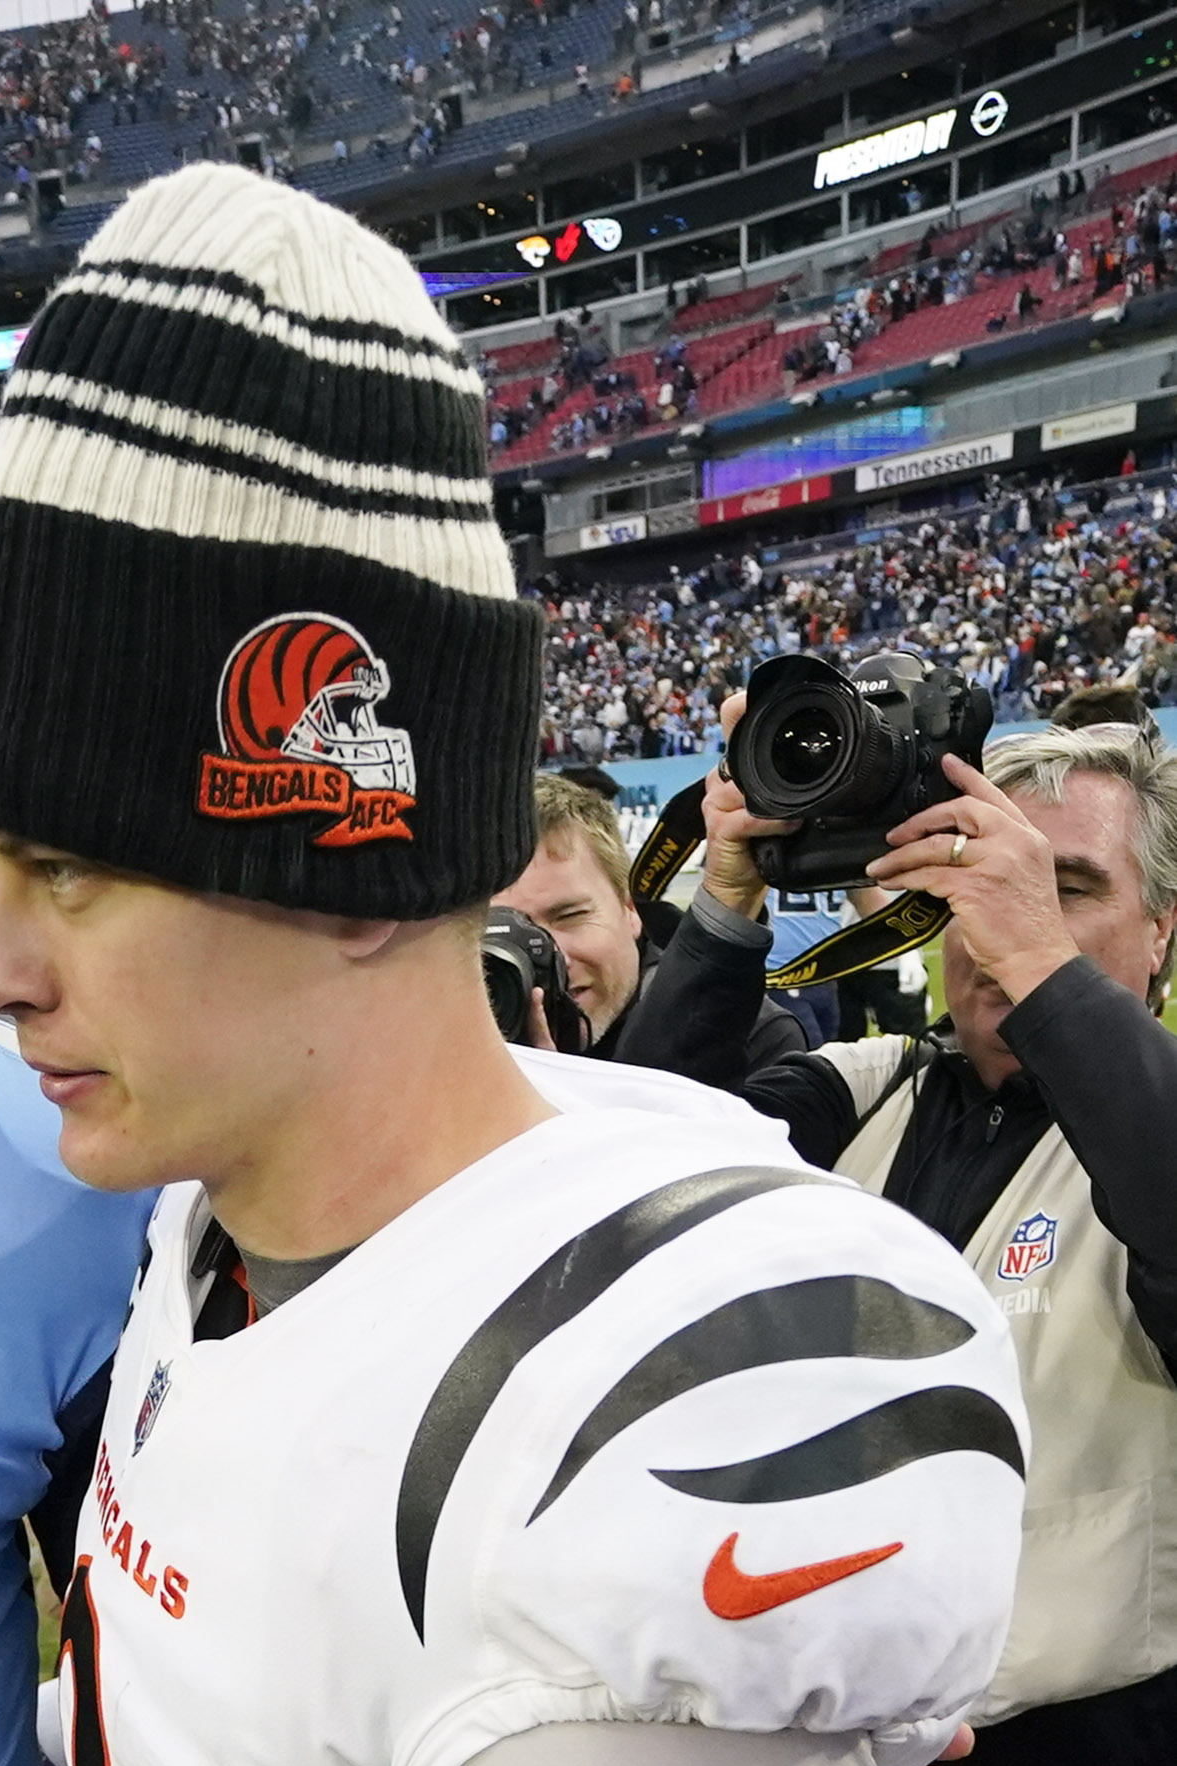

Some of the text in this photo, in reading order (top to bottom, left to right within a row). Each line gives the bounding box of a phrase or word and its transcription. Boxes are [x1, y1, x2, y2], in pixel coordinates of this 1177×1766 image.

[208, 767, 342, 809] BENGALS
[349, 798, 397, 833] AFC
[1004, 1244, 1047, 1274] NFL
